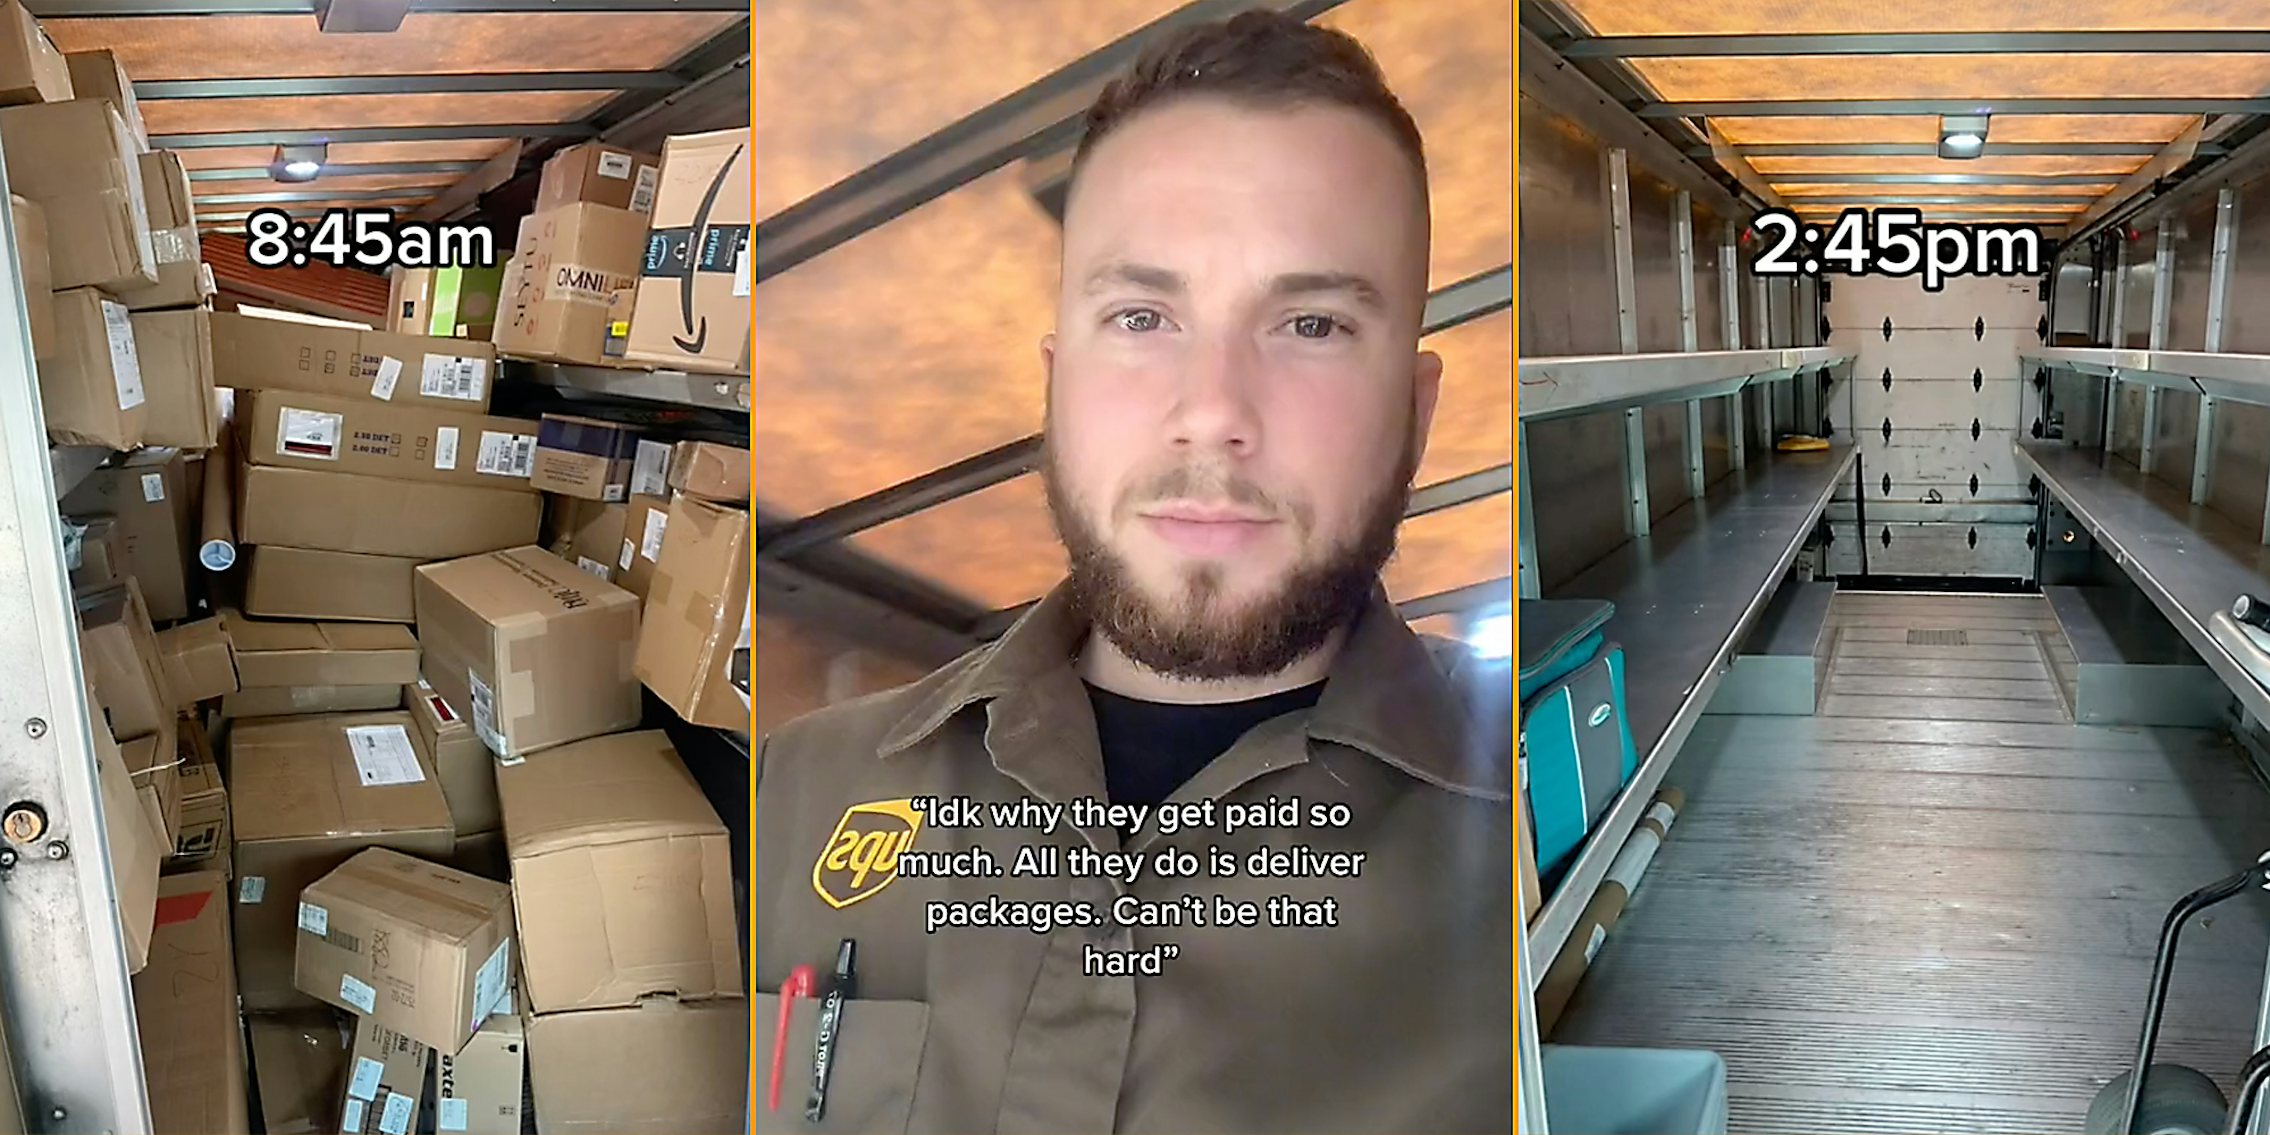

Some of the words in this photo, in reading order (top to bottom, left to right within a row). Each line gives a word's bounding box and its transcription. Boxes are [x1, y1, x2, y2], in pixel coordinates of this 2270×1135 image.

[646, 234, 661, 270] prime
[705, 228, 720, 266] prime
[442, 1054, 454, 1099] axte
